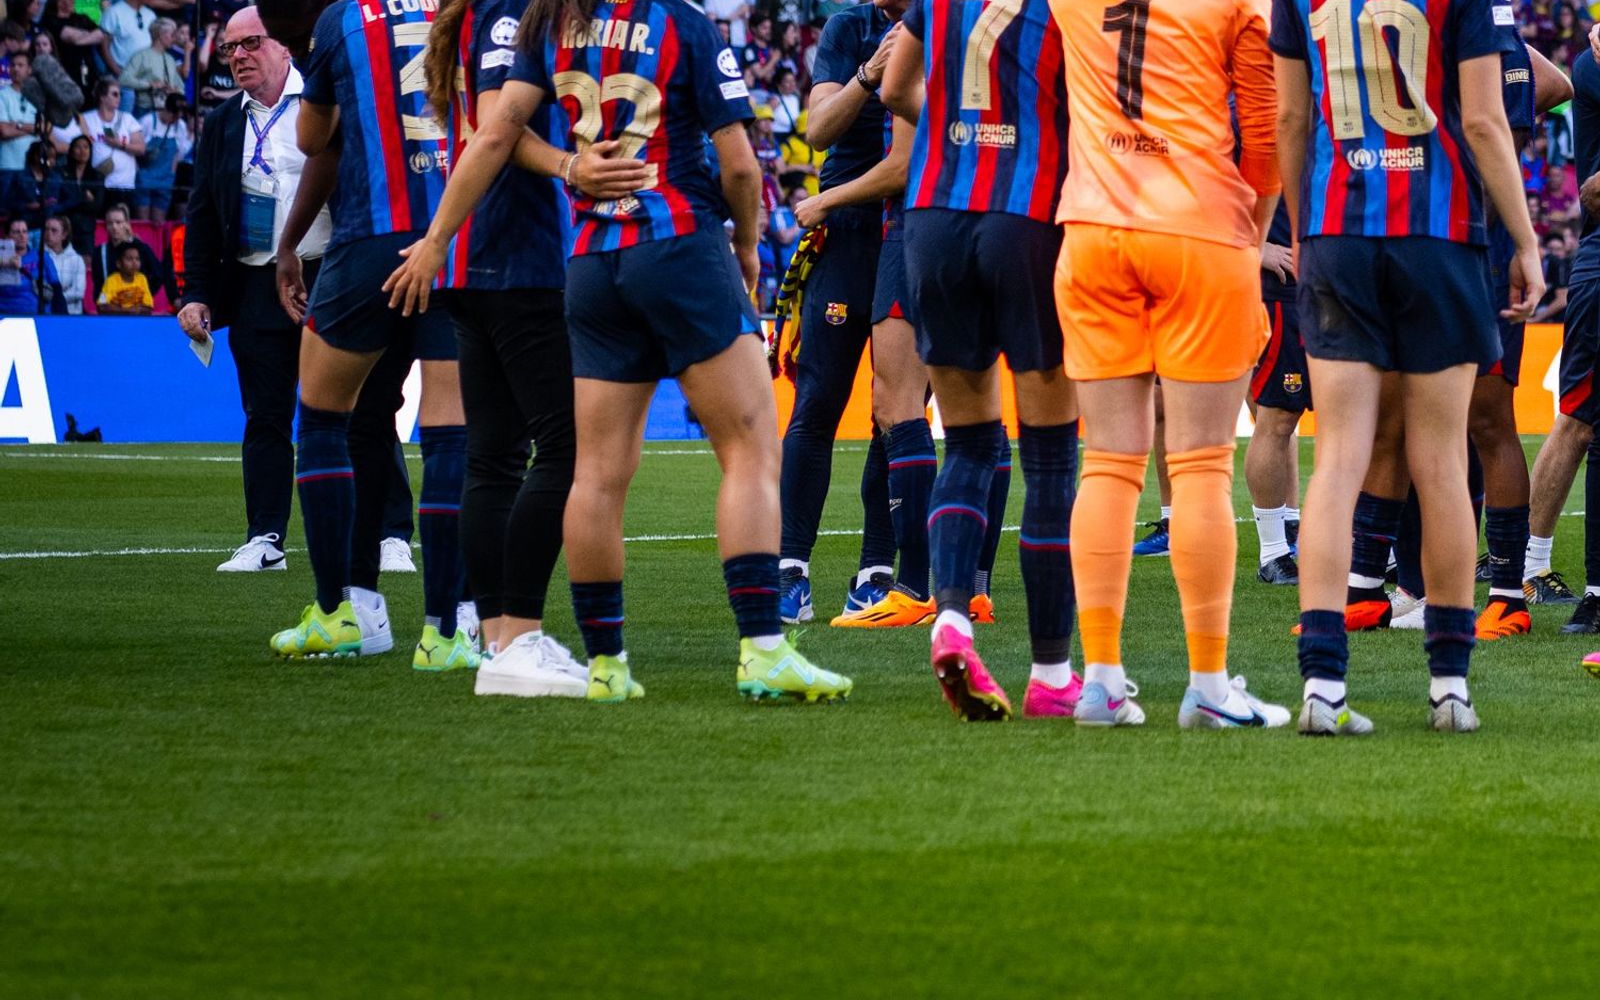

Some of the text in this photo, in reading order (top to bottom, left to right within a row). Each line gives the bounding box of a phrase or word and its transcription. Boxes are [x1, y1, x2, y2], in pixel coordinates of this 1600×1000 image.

[362, 4, 387, 23] L.
[974, 123, 1016, 136] UNHCR
[973, 134, 1016, 145] ACNUR
[1379, 146, 1424, 159] UNHCR
[1379, 157, 1425, 169] ACNUR
[0, 318, 57, 444] A
